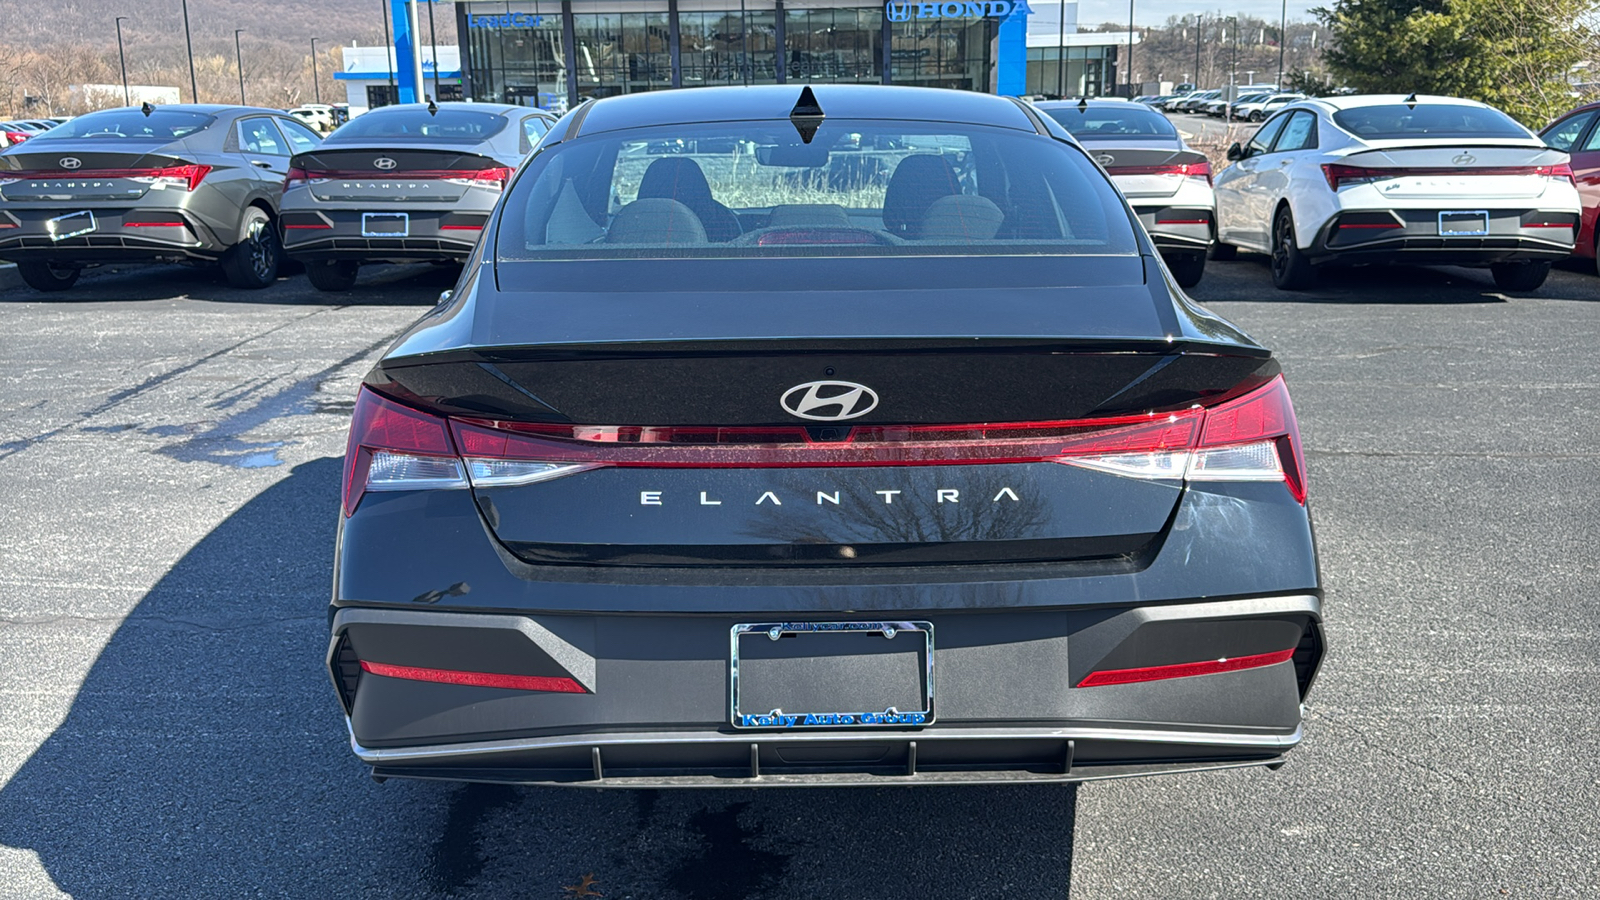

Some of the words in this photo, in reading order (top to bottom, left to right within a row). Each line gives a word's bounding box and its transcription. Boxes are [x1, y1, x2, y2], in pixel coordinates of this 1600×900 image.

[916, 0, 1035, 18] HONDA
[467, 11, 544, 28] LeadCar
[640, 487, 1020, 505] ELANTRA
[742, 714, 797, 727] Kelly
[803, 713, 854, 725] Auto
[861, 712, 926, 726] Group
